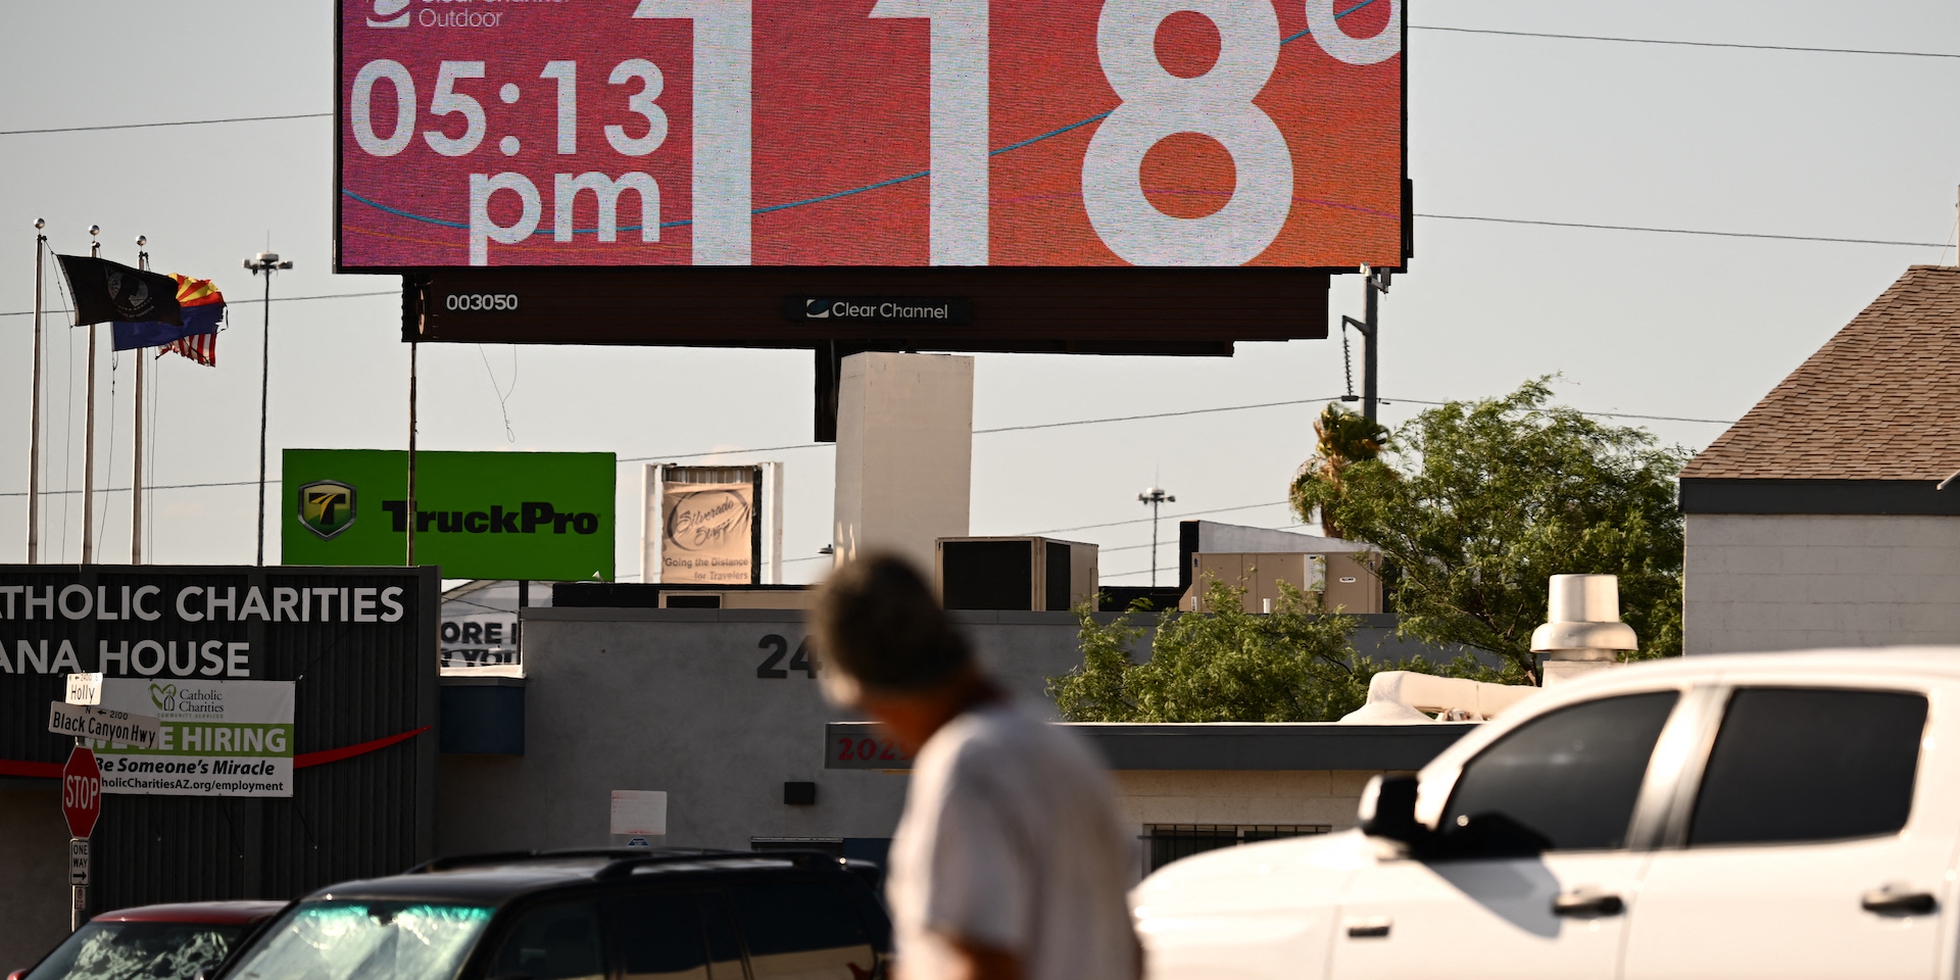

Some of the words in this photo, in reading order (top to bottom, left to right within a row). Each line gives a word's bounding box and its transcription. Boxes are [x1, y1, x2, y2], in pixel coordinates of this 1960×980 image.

[419, 8, 502, 27] Outdoor
[350, 59, 668, 156] 05:13
[469, 172, 661, 266] pm
[446, 294, 518, 310] 003050
[832, 302, 876, 317] Clear
[880, 303, 948, 319] Channel
[382, 500, 599, 535] TruckPro
[676, 496, 734, 534] Silverado
[695, 558, 709, 567] the
[711, 558, 748, 567] Distance
[709, 571, 749, 580] Travelers
[0, 584, 161, 621] THOLIC
[176, 586, 404, 623] CHARITIES
[100, 641, 250, 677] HOUSE
[757, 634, 829, 679] 24
[71, 684, 95, 704] Holly
[179, 688, 223, 701] Catholic
[109, 710, 129, 721] 2100
[179, 701, 225, 713] Charities
[53, 711, 85, 733] Black
[88, 717, 129, 742] Canyon
[131, 724, 156, 749] Hwy
[182, 727, 286, 753] HIRING
[212, 760, 275, 776] Miracle
[66, 775, 98, 810] STOP
[101, 777, 284, 793] holicCharitiesAZ.org/employment
[73, 845, 88, 855] ONE
[73, 858, 88, 868] WAY
